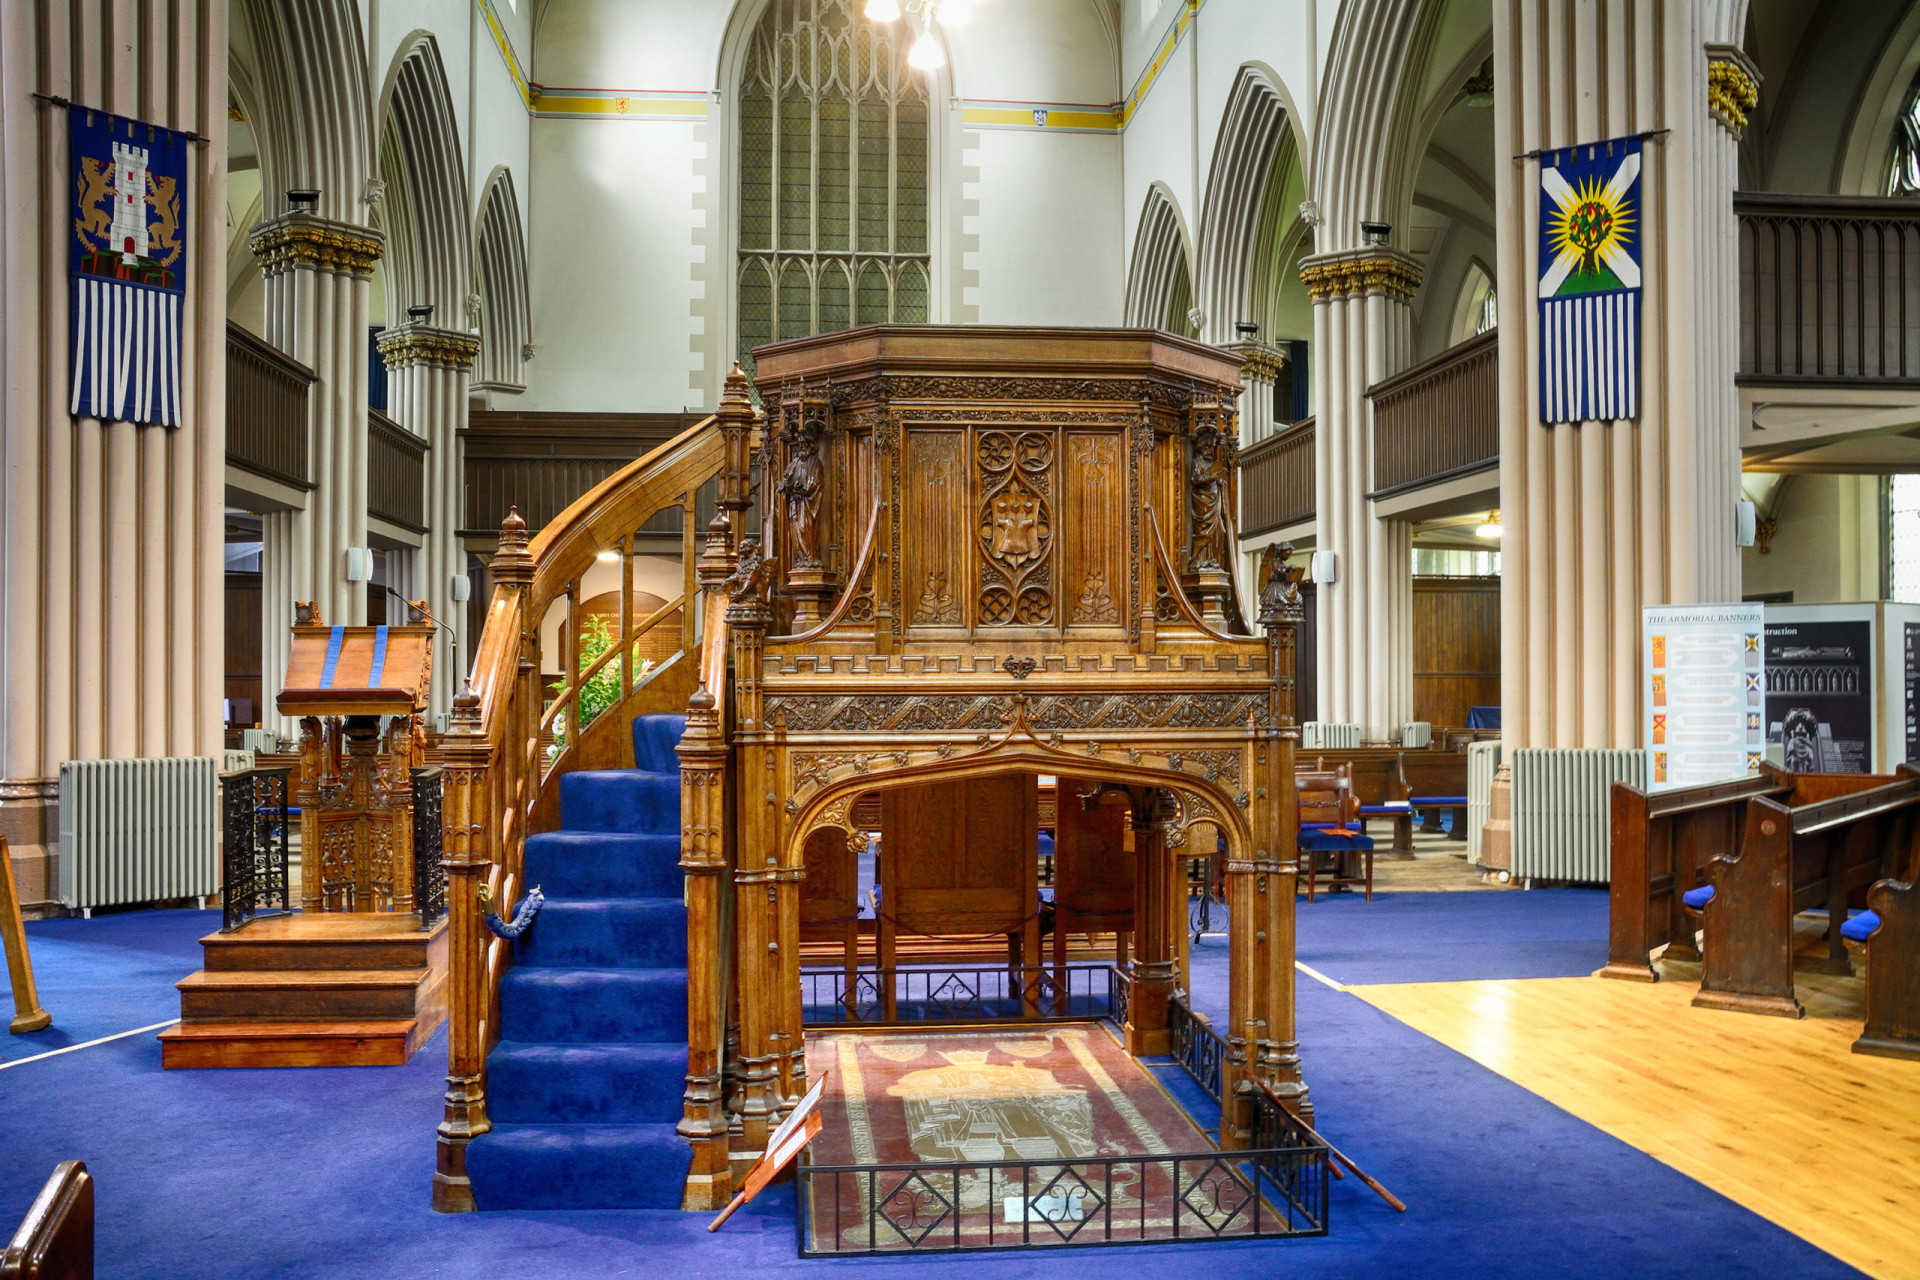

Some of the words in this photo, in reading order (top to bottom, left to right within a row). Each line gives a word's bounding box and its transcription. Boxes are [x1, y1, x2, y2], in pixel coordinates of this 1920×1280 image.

[1648, 616, 1666, 624] THE
[1667, 614, 1716, 623] ARMORIAL
[1718, 613, 1761, 622] BANNERS
